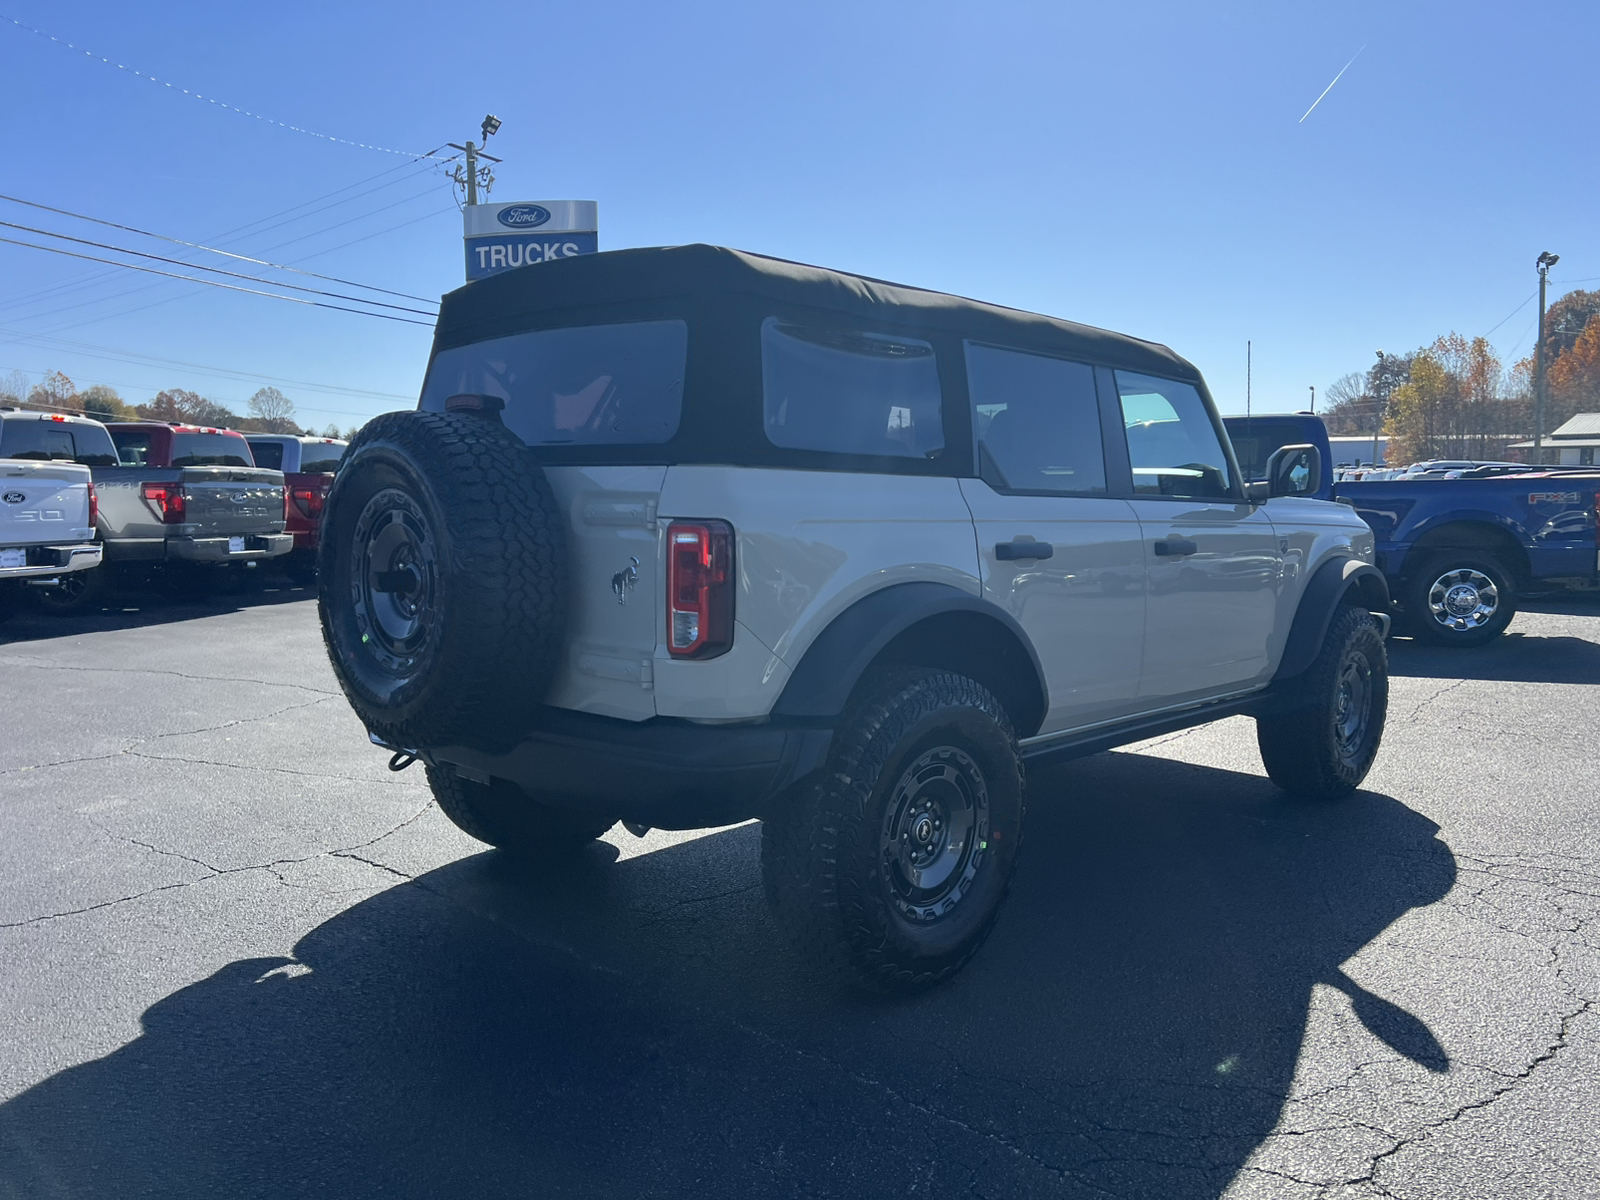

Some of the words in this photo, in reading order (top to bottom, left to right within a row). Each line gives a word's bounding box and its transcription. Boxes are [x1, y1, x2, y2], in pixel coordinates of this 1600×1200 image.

[508, 208, 537, 222] Ford
[475, 242, 579, 268] TRUCKS
[1528, 492, 1580, 504] FX4
